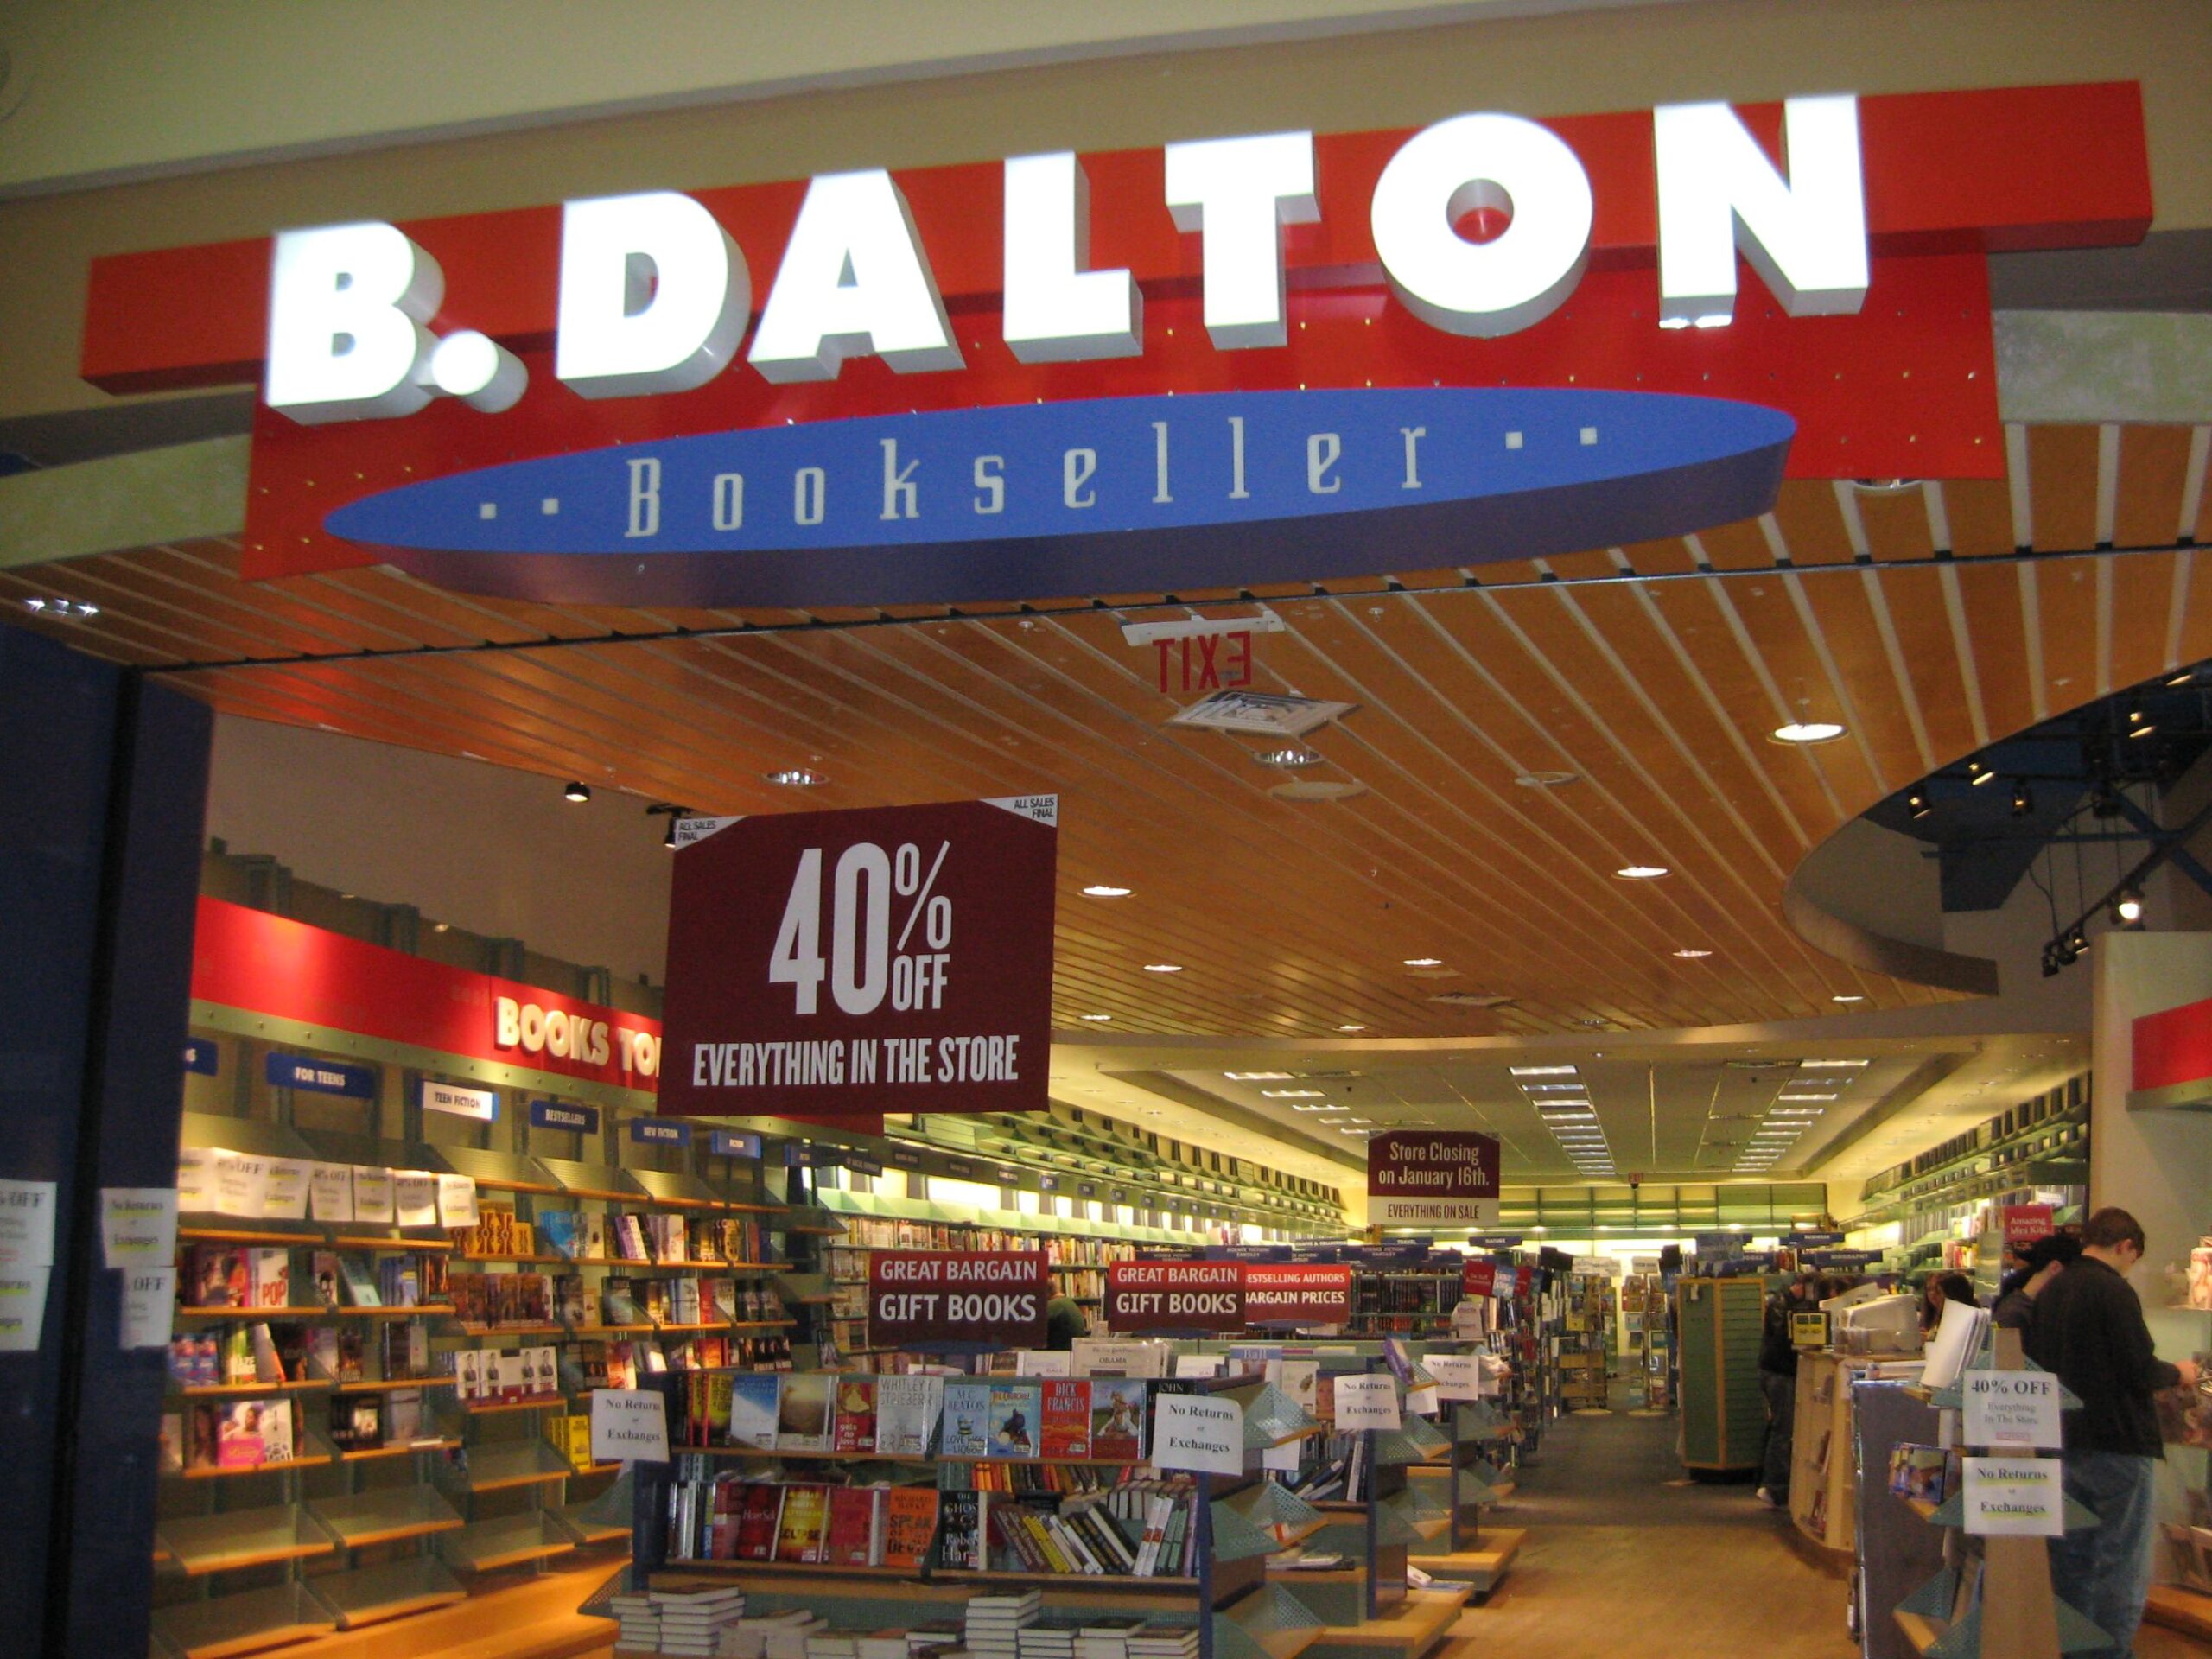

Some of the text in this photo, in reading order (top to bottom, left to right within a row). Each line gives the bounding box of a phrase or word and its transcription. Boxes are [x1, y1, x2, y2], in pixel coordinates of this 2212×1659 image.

[265, 93, 1873, 418] B. DALTON
[624, 417, 1427, 537] Bookseller
[1014, 797, 1054, 809] ALL SALES
[1032, 808, 1054, 818] FINAL
[769, 840, 951, 1015] 40%
[892, 953, 950, 1012] OFF
[496, 995, 610, 1066] BOOKS
[693, 1035, 1020, 1086] EVERYTHING IN THE STORE
[294, 1066, 346, 1087] FOR TEENS
[435, 1091, 482, 1109] TEEN FICTION
[545, 1109, 586, 1126] BESTSELLERS
[1389, 1141, 1479, 1166] Store Closing
[1378, 1166, 1490, 1189] on January 16th.
[1388, 1204, 1479, 1219] EVERYTHING ON SALE
[880, 1259, 1038, 1281] GREAT BARGAIN
[1116, 1267, 1238, 1284] GREAT BARGAIN
[1247, 1273, 1345, 1283] ESTSELLING AUTHORS
[133, 1276, 167, 1292] OFF
[262, 1280, 286, 1306] POP
[1301, 1291, 1345, 1304] PRICES
[879, 1294, 1037, 1321] GIFT BOOKS
[1116, 1293, 1237, 1315] GIFT BOOKS
[1243, 1349, 1268, 1359] Ball
[1443, 1360, 1471, 1369] Returns
[1055, 1382, 1077, 1397] DICK
[1158, 1382, 1184, 1393] JOHN
[1359, 1382, 1392, 1391] Returns
[1438, 1380, 1470, 1389] xchanges
[1971, 1379, 2051, 1395] 40% OFF
[607, 1398, 621, 1409] No
[1046, 1396, 1085, 1412] FRANCIS
[1346, 1405, 1392, 1415] Exchanges
[1987, 1402, 2037, 1414] Everything
[1168, 1403, 1235, 1421] No Returns
[607, 1428, 661, 1443] Exchanges
[1168, 1436, 1230, 1454] Exchanges
[1977, 1467, 2048, 1480] No Returns
[944, 1503, 978, 1514] GHOS
[1980, 1501, 2047, 1515] Exchanges
